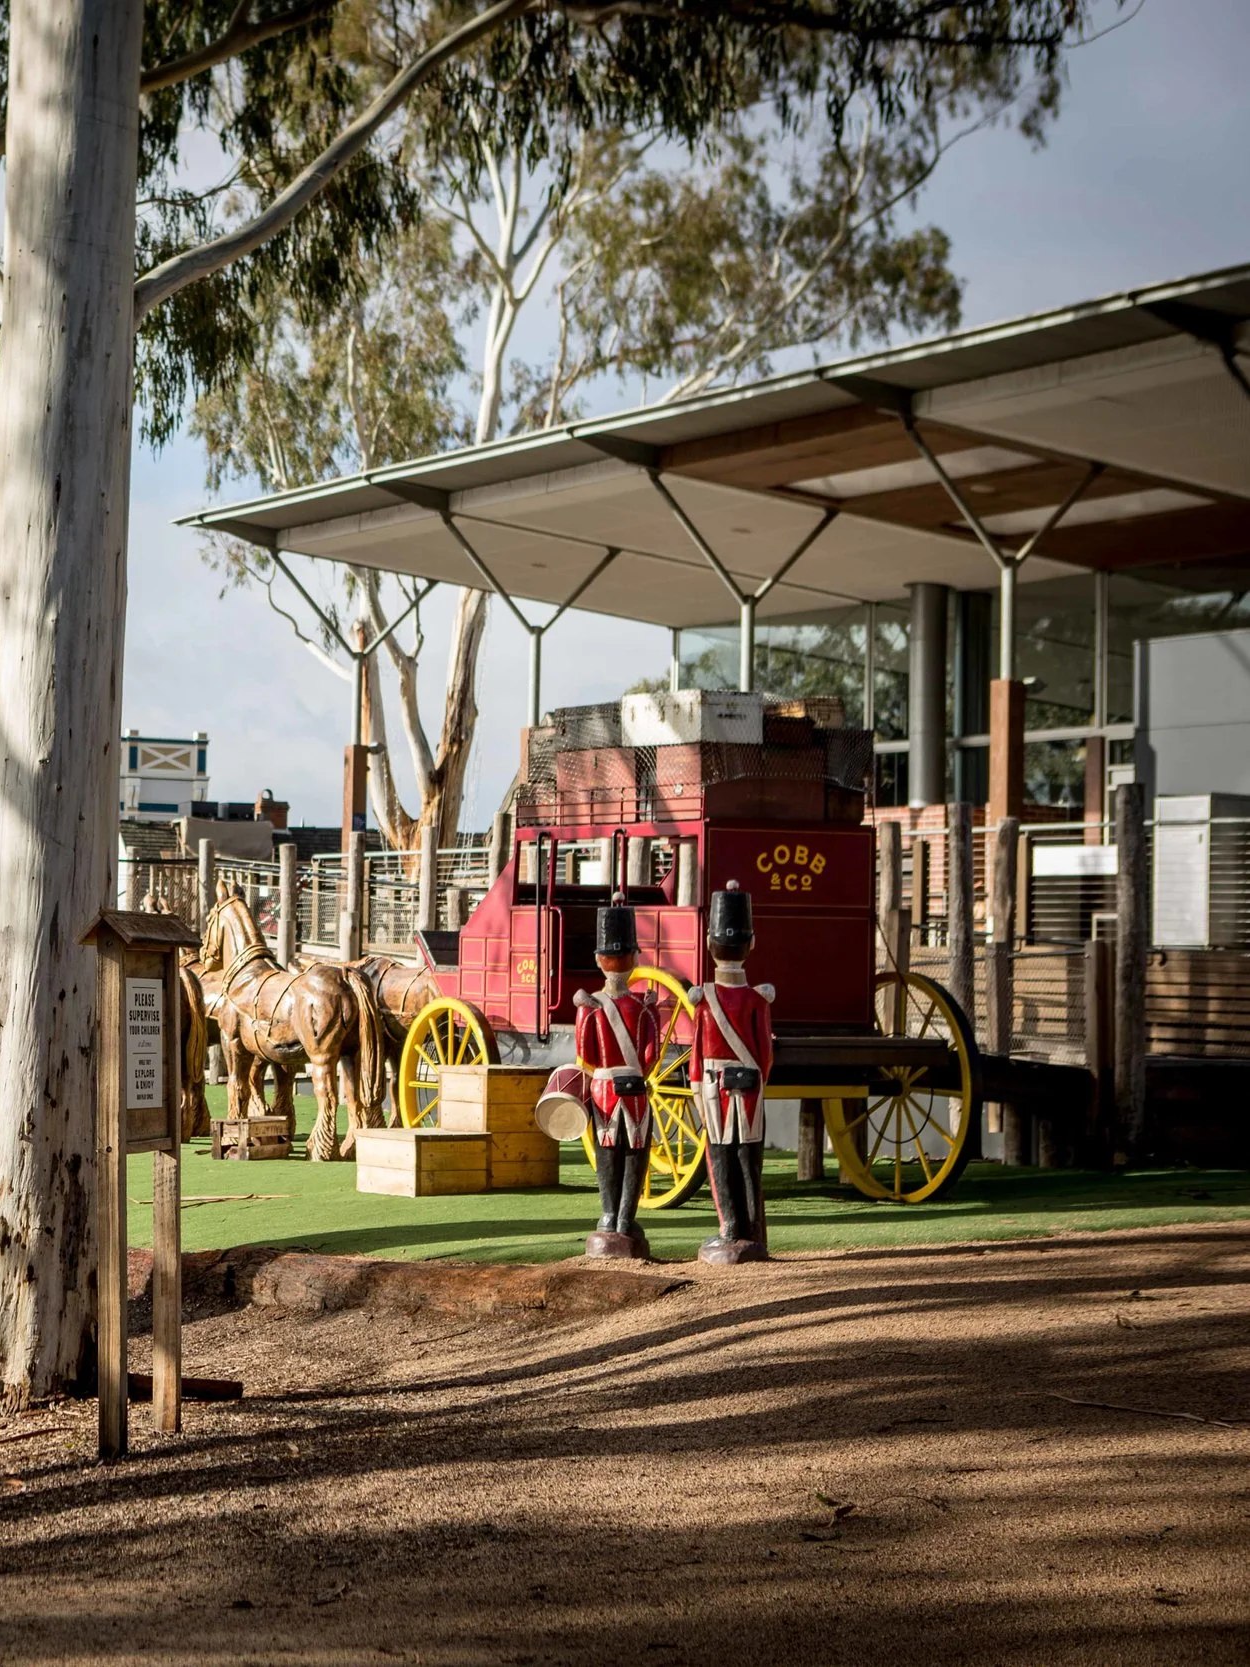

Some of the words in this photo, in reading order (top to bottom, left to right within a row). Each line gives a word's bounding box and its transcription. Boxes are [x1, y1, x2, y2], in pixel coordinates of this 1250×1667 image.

[756, 844, 826, 874] COBB
[134, 993, 154, 1006] PLEASE
[129, 1010, 160, 1021] SUPERVISE
[129, 1025, 140, 1035] YOUR
[141, 1025, 160, 1035] CHILDREN
[134, 1069, 155, 1078] EXPLORE
[140, 1080, 154, 1089] ENJOY
